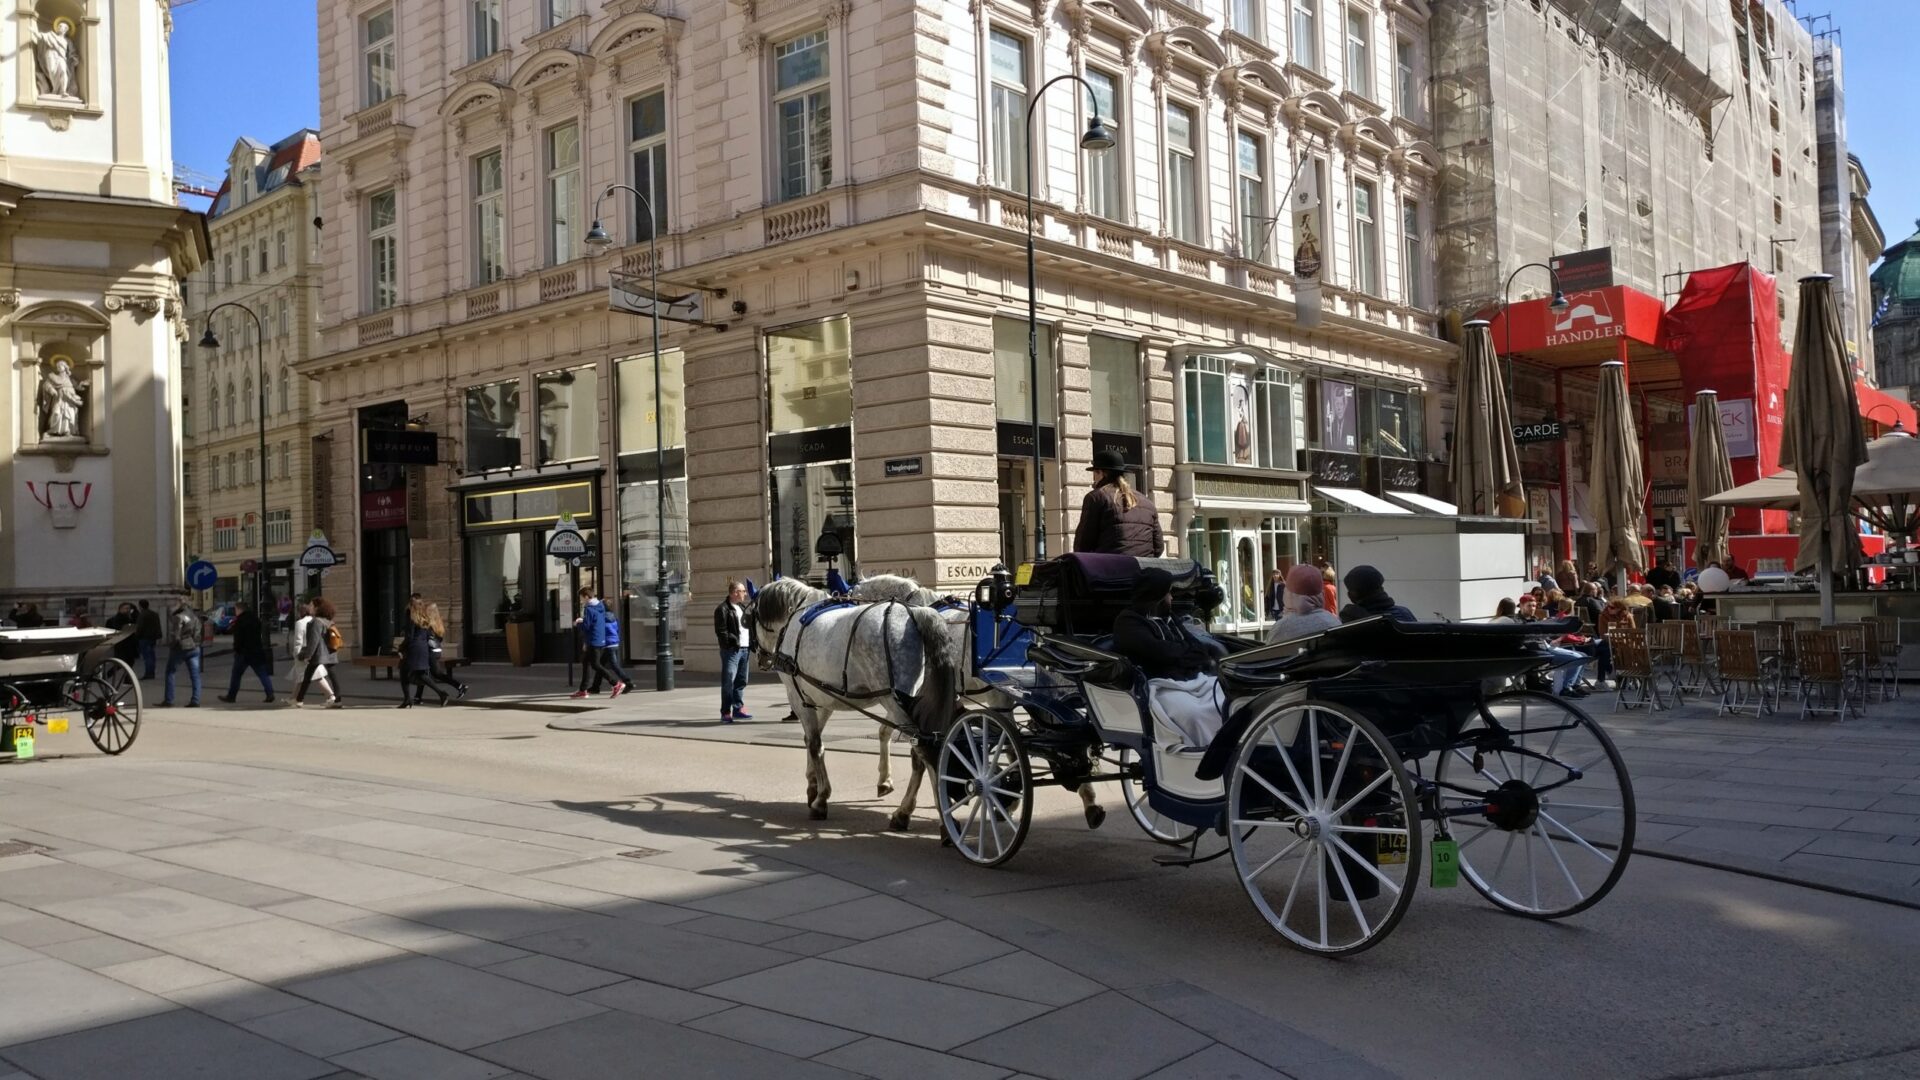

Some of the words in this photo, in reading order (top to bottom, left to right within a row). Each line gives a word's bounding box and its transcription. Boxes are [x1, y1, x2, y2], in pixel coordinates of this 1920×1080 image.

[1546, 325, 1624, 346] HANDLER
[1013, 435, 1034, 446] ESCAD
[1664, 455, 1689, 468] BRA
[947, 566, 988, 578] ESCADA
[1438, 852, 1450, 863] 10
